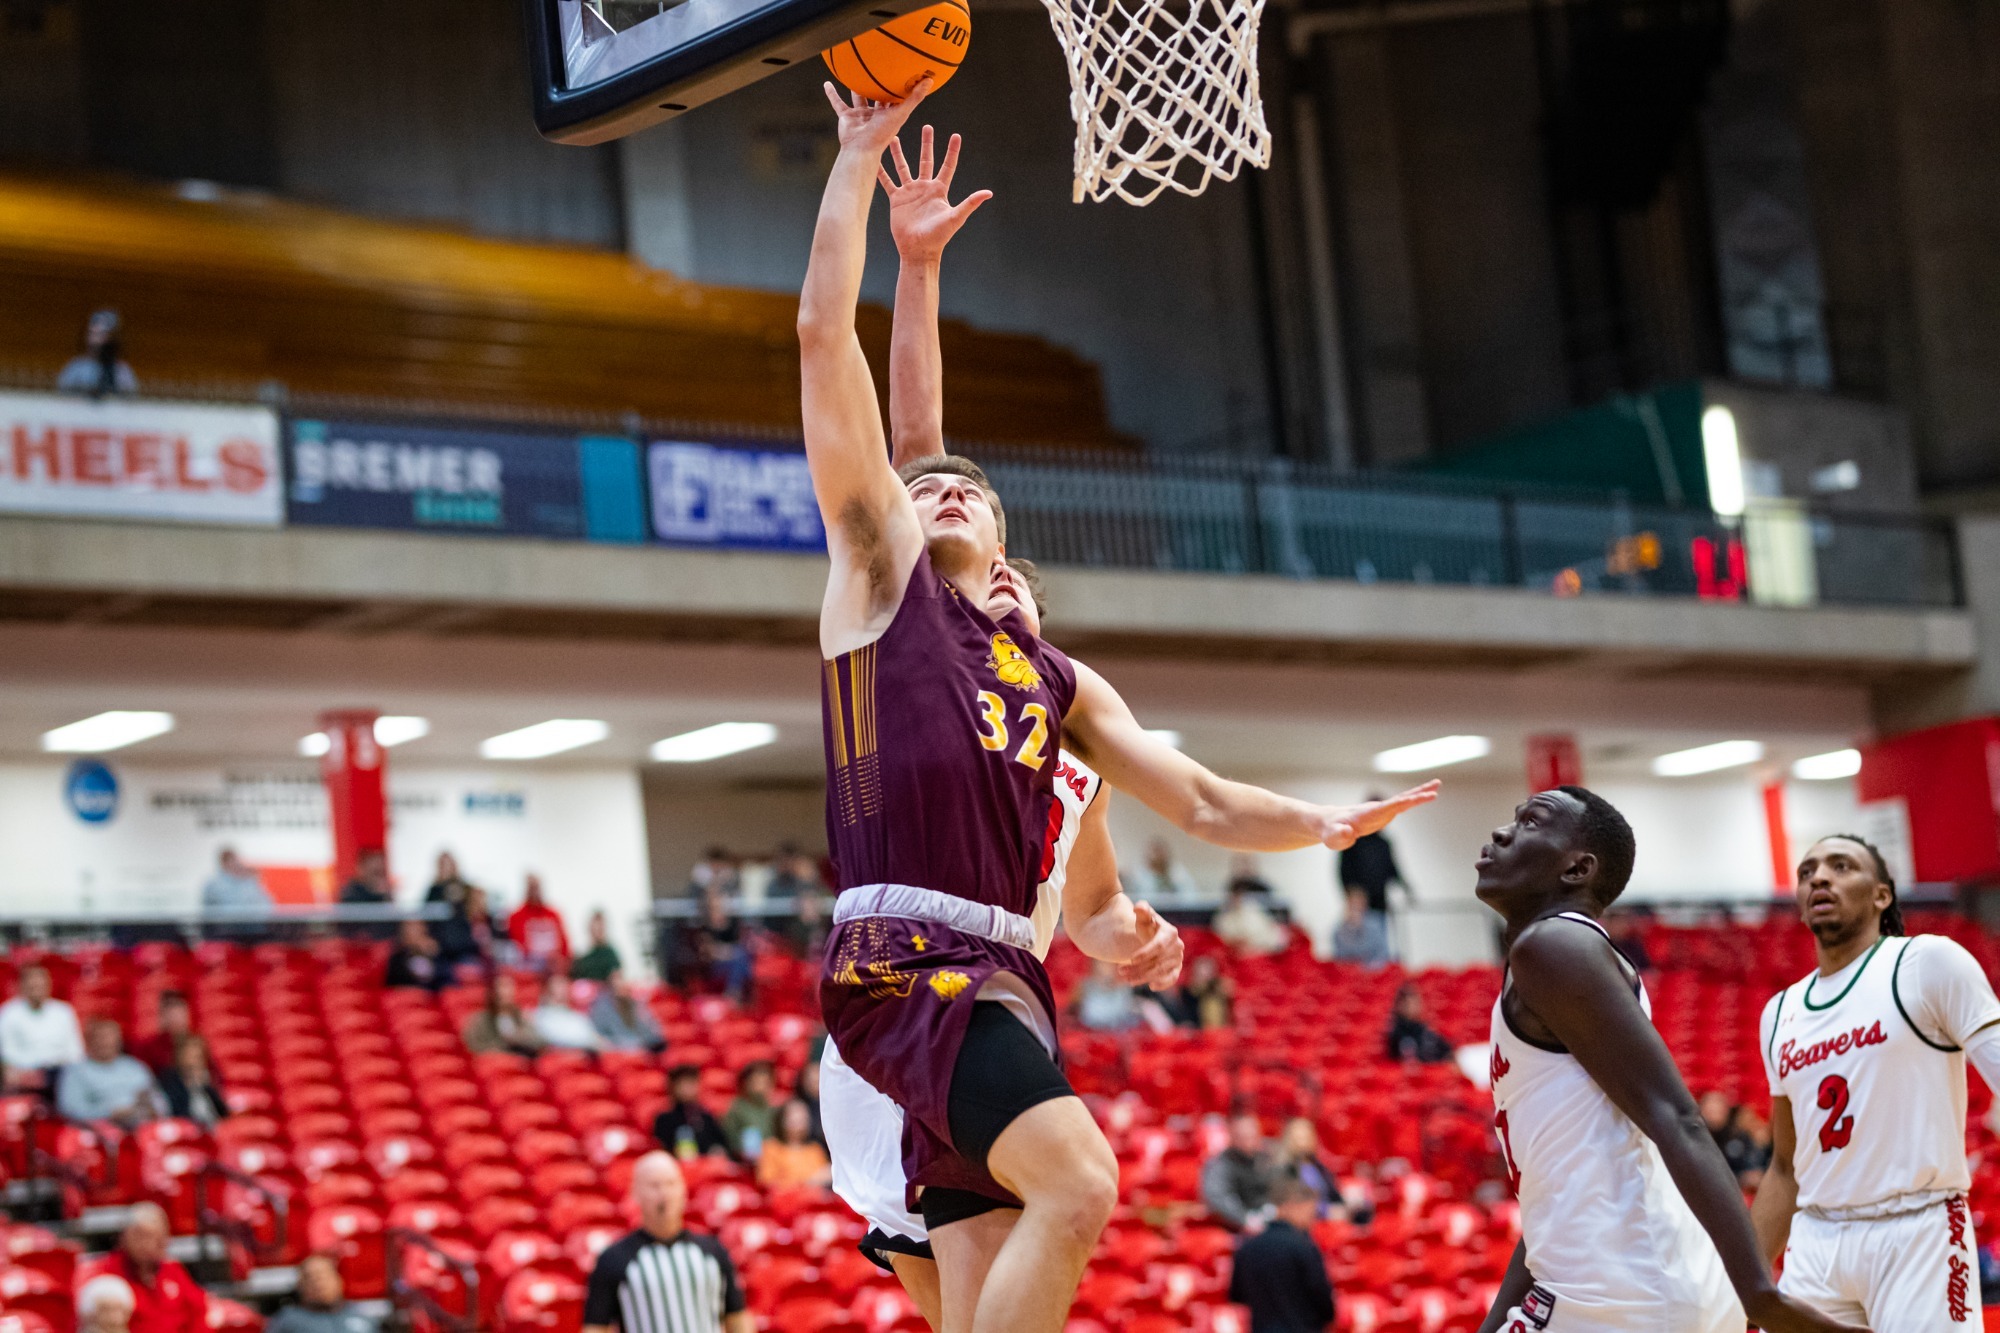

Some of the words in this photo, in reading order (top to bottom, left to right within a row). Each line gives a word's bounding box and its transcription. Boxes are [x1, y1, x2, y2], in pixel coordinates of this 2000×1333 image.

[923, 17, 967, 47] EVO
[0, 425, 268, 496] HEELS
[296, 439, 501, 494] BREMER
[976, 689, 1049, 772] 32
[1778, 1019, 1888, 1081] Beavers
[1817, 1073, 1854, 1153] 2
[1947, 1254, 1973, 1323] State
